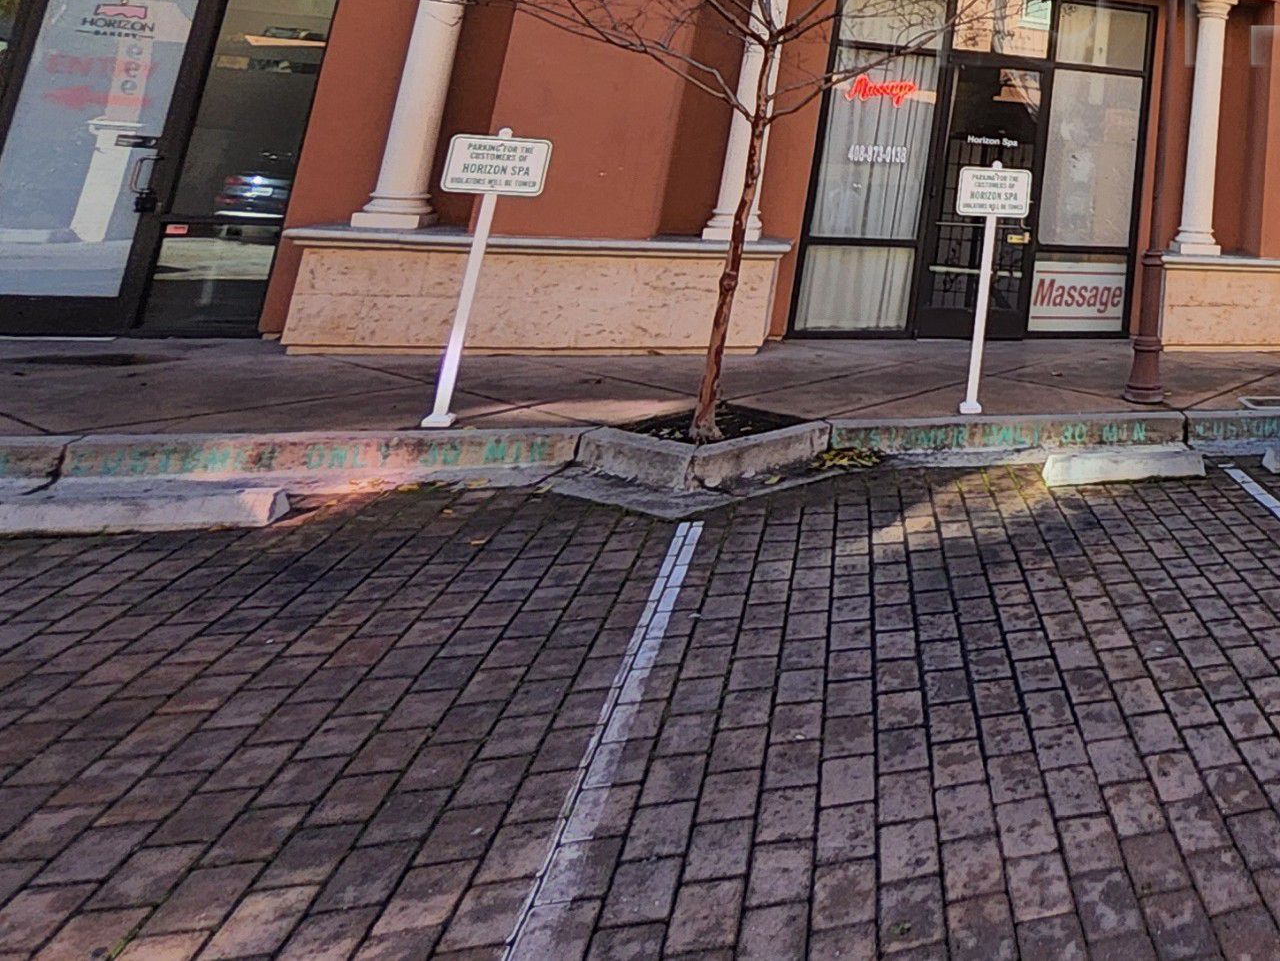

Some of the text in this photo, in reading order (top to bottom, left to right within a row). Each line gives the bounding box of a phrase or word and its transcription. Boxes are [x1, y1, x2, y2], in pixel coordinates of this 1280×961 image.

[82, 17, 155, 32] HORIZON
[93, 29, 139, 38] BAKERY
[967, 135, 1018, 147] Horizon Spa
[503, 144, 518, 153] FOR
[520, 146, 535, 154] THE
[462, 163, 530, 177] HORIZON SPA
[970, 190, 1018, 201] HORIZON SPA
[1033, 278, 1123, 314] Massage
[306, 440, 393, 469] ONLY
[483, 436, 551, 464] MIN
